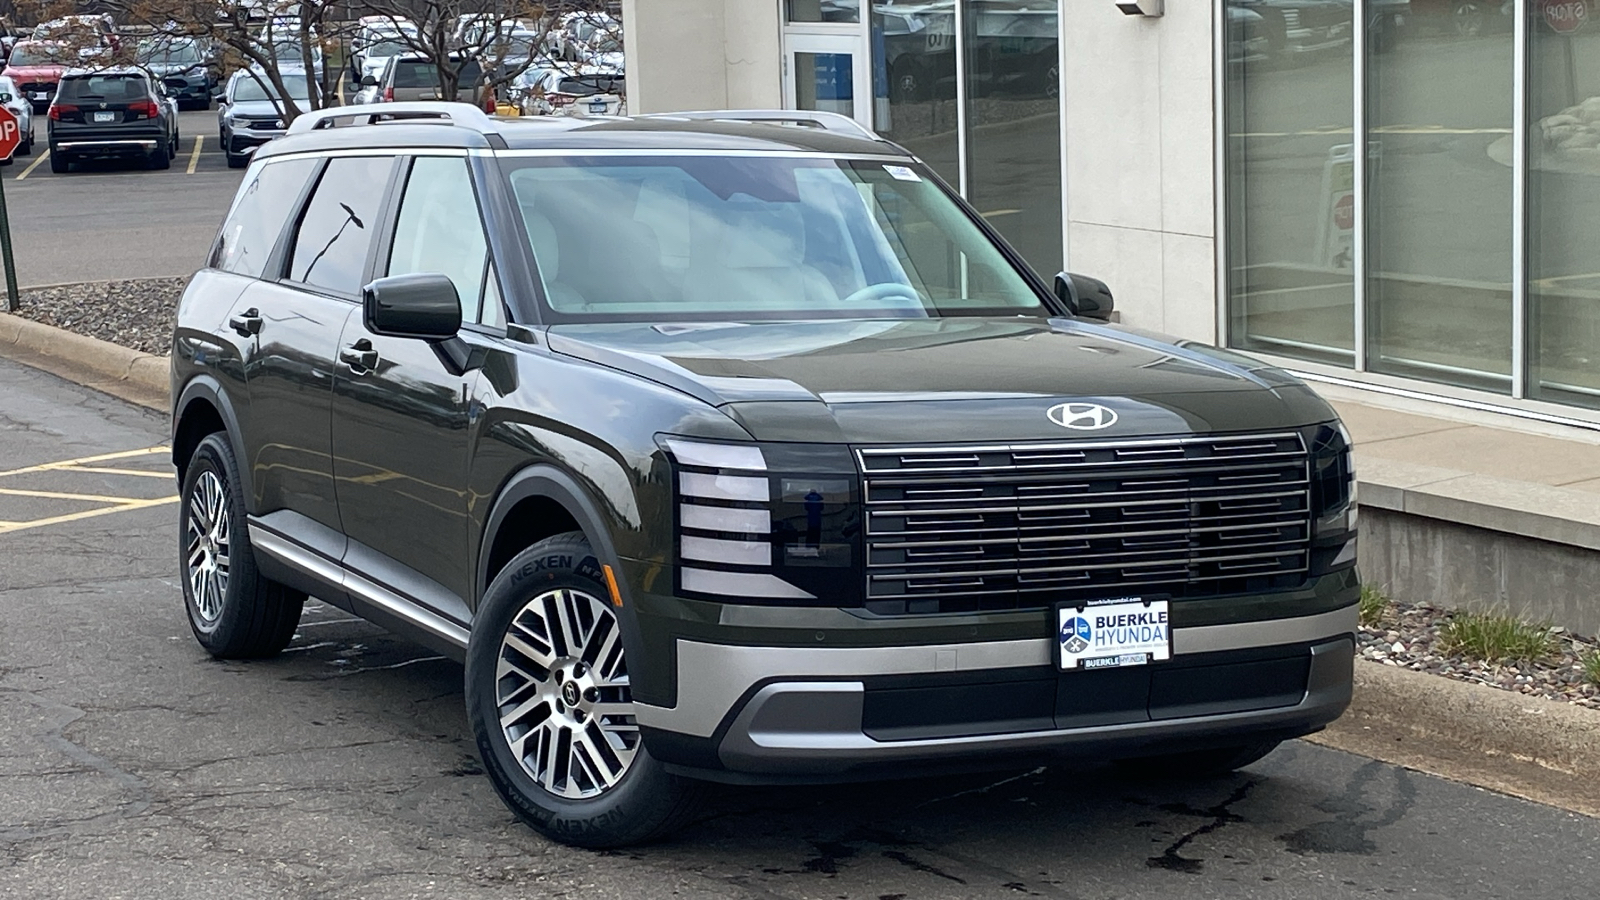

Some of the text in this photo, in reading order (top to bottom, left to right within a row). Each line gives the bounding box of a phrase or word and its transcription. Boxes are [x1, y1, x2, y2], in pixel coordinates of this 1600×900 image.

[510, 555, 573, 586] NEXEN
[1095, 611, 1168, 629] BUERKLE
[1095, 625, 1168, 646] HYUNDAI
[1085, 655, 1146, 668] BUERKLE HYUNDAI
[556, 805, 624, 833] NEXEN
